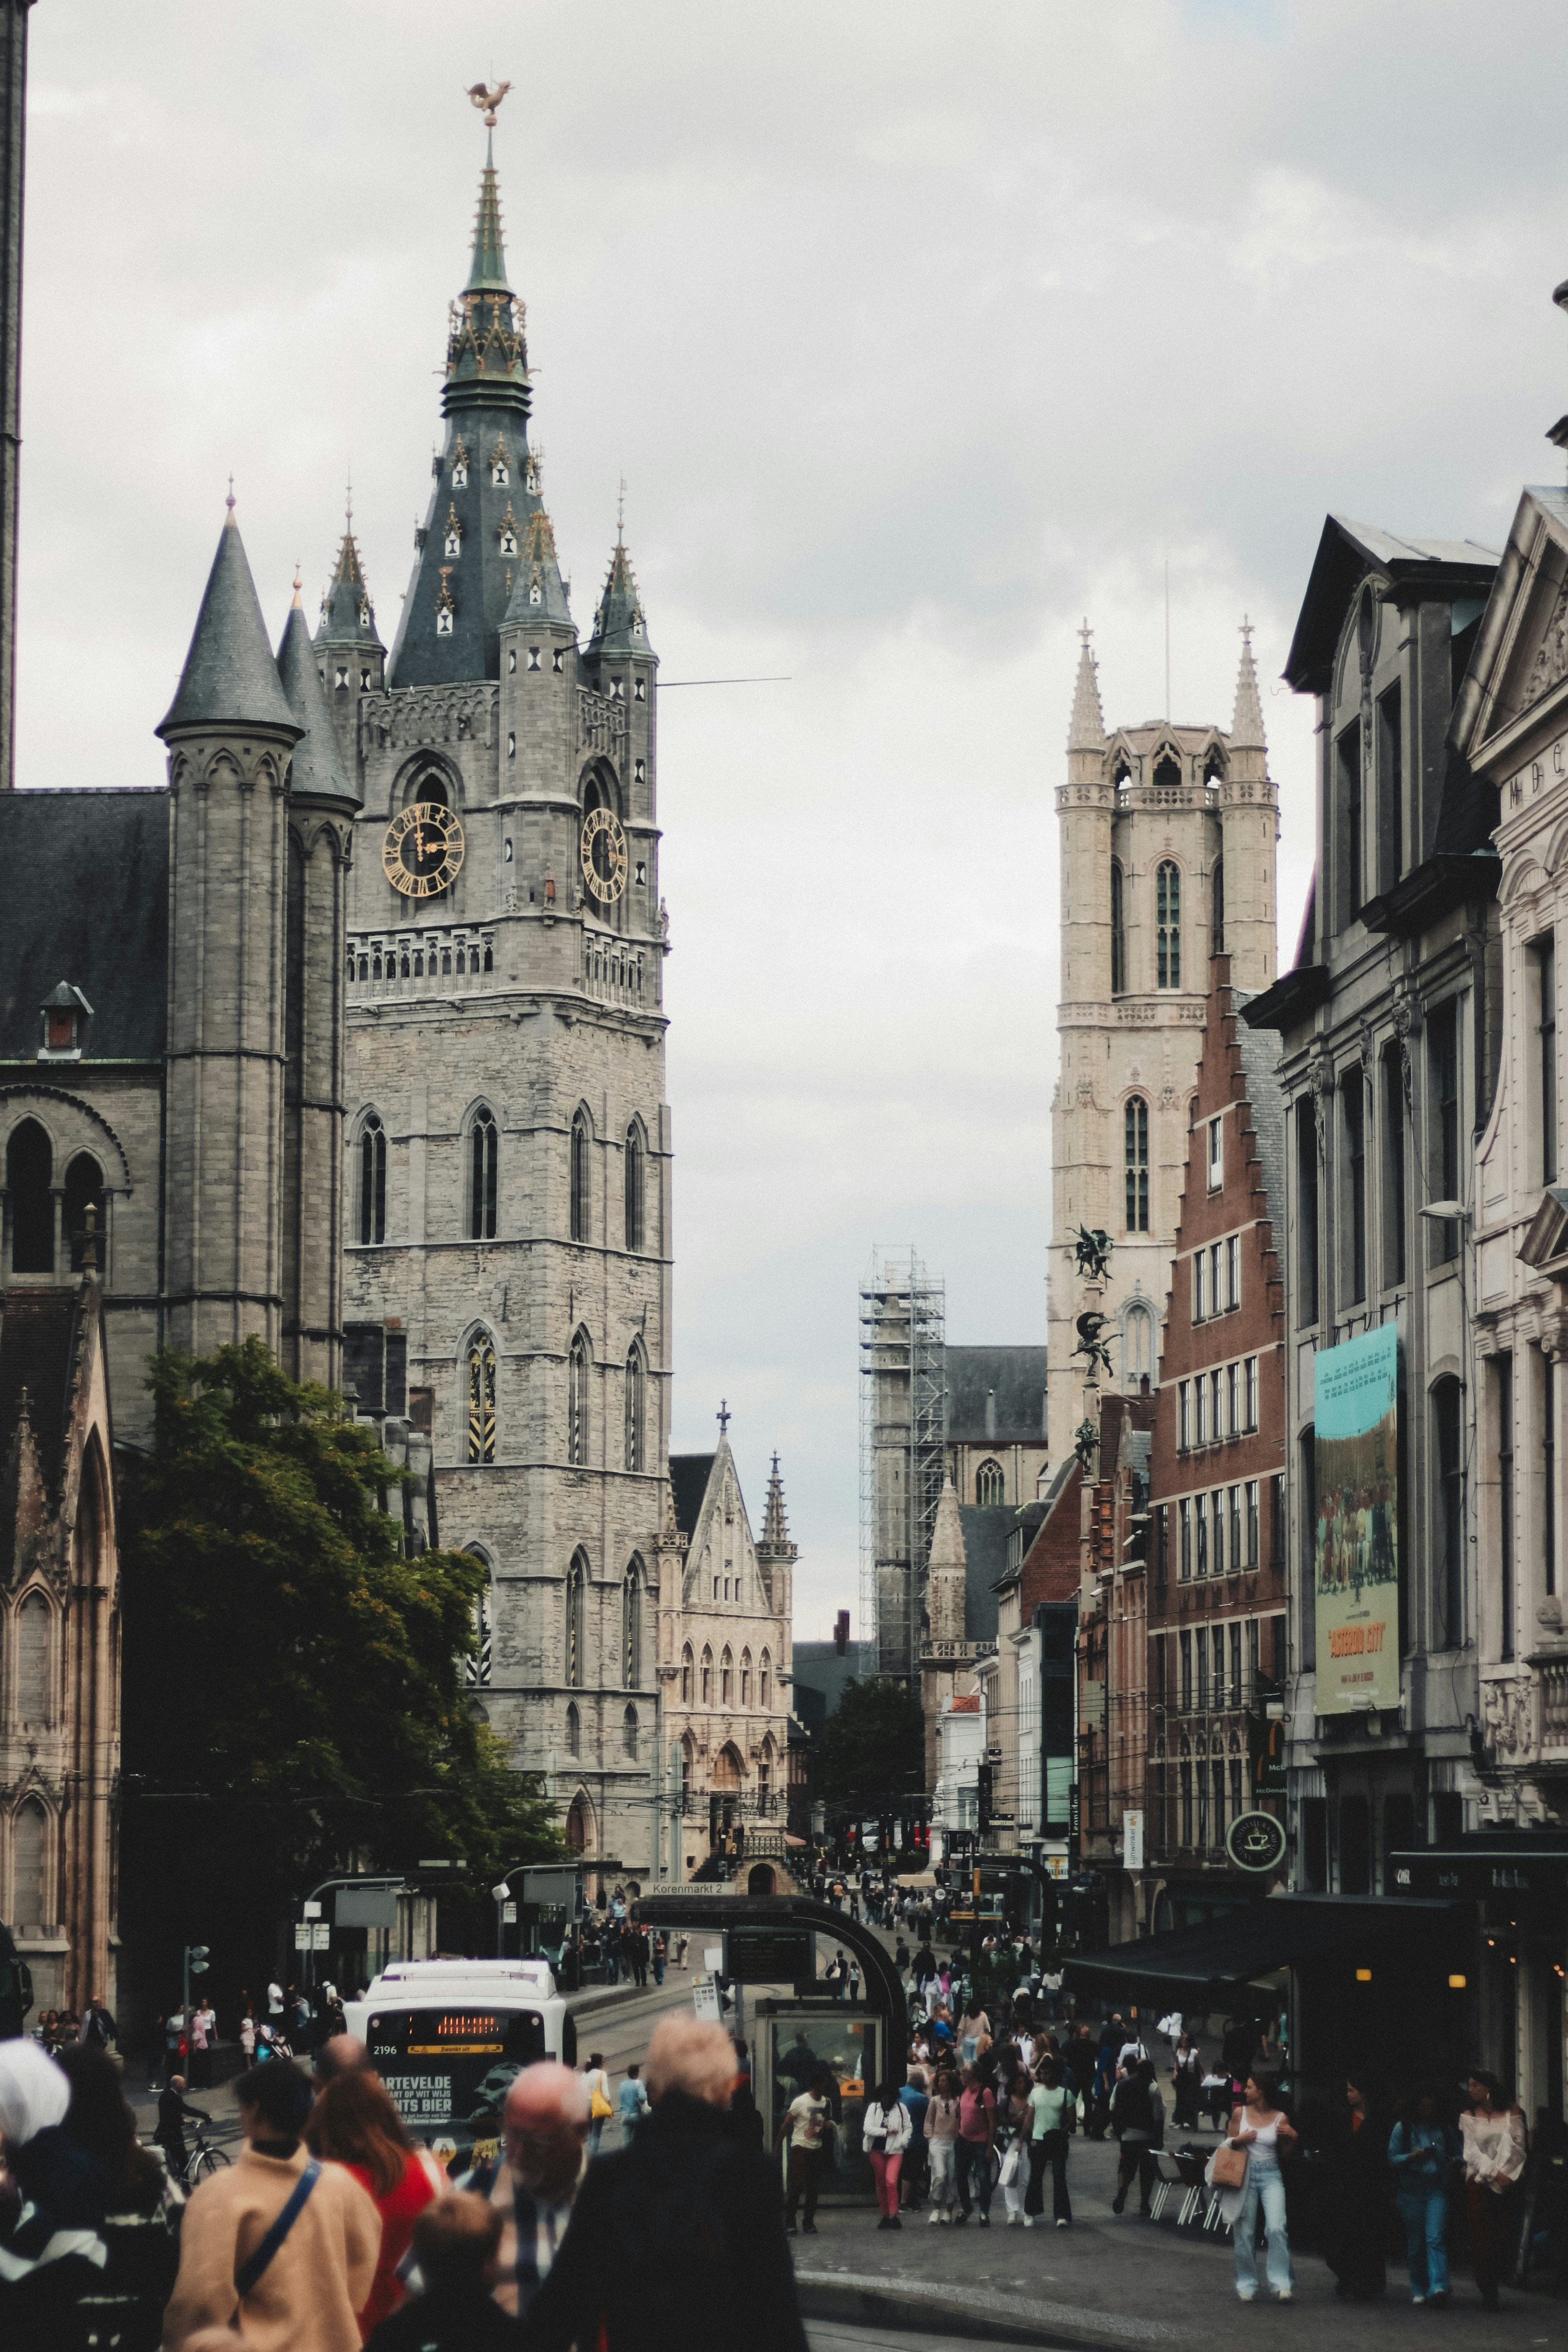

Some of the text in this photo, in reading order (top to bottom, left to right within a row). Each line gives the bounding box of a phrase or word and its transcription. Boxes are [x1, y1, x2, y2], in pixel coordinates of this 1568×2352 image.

[1129, 1829, 1137, 1865] Lijnwinkel
[654, 1884, 722, 1893] Korenmarkt 2
[373, 2046, 397, 2055] 2196
[378, 2076, 451, 2089] ARTEVELDE
[393, 2099, 451, 2112] NTS BIER
